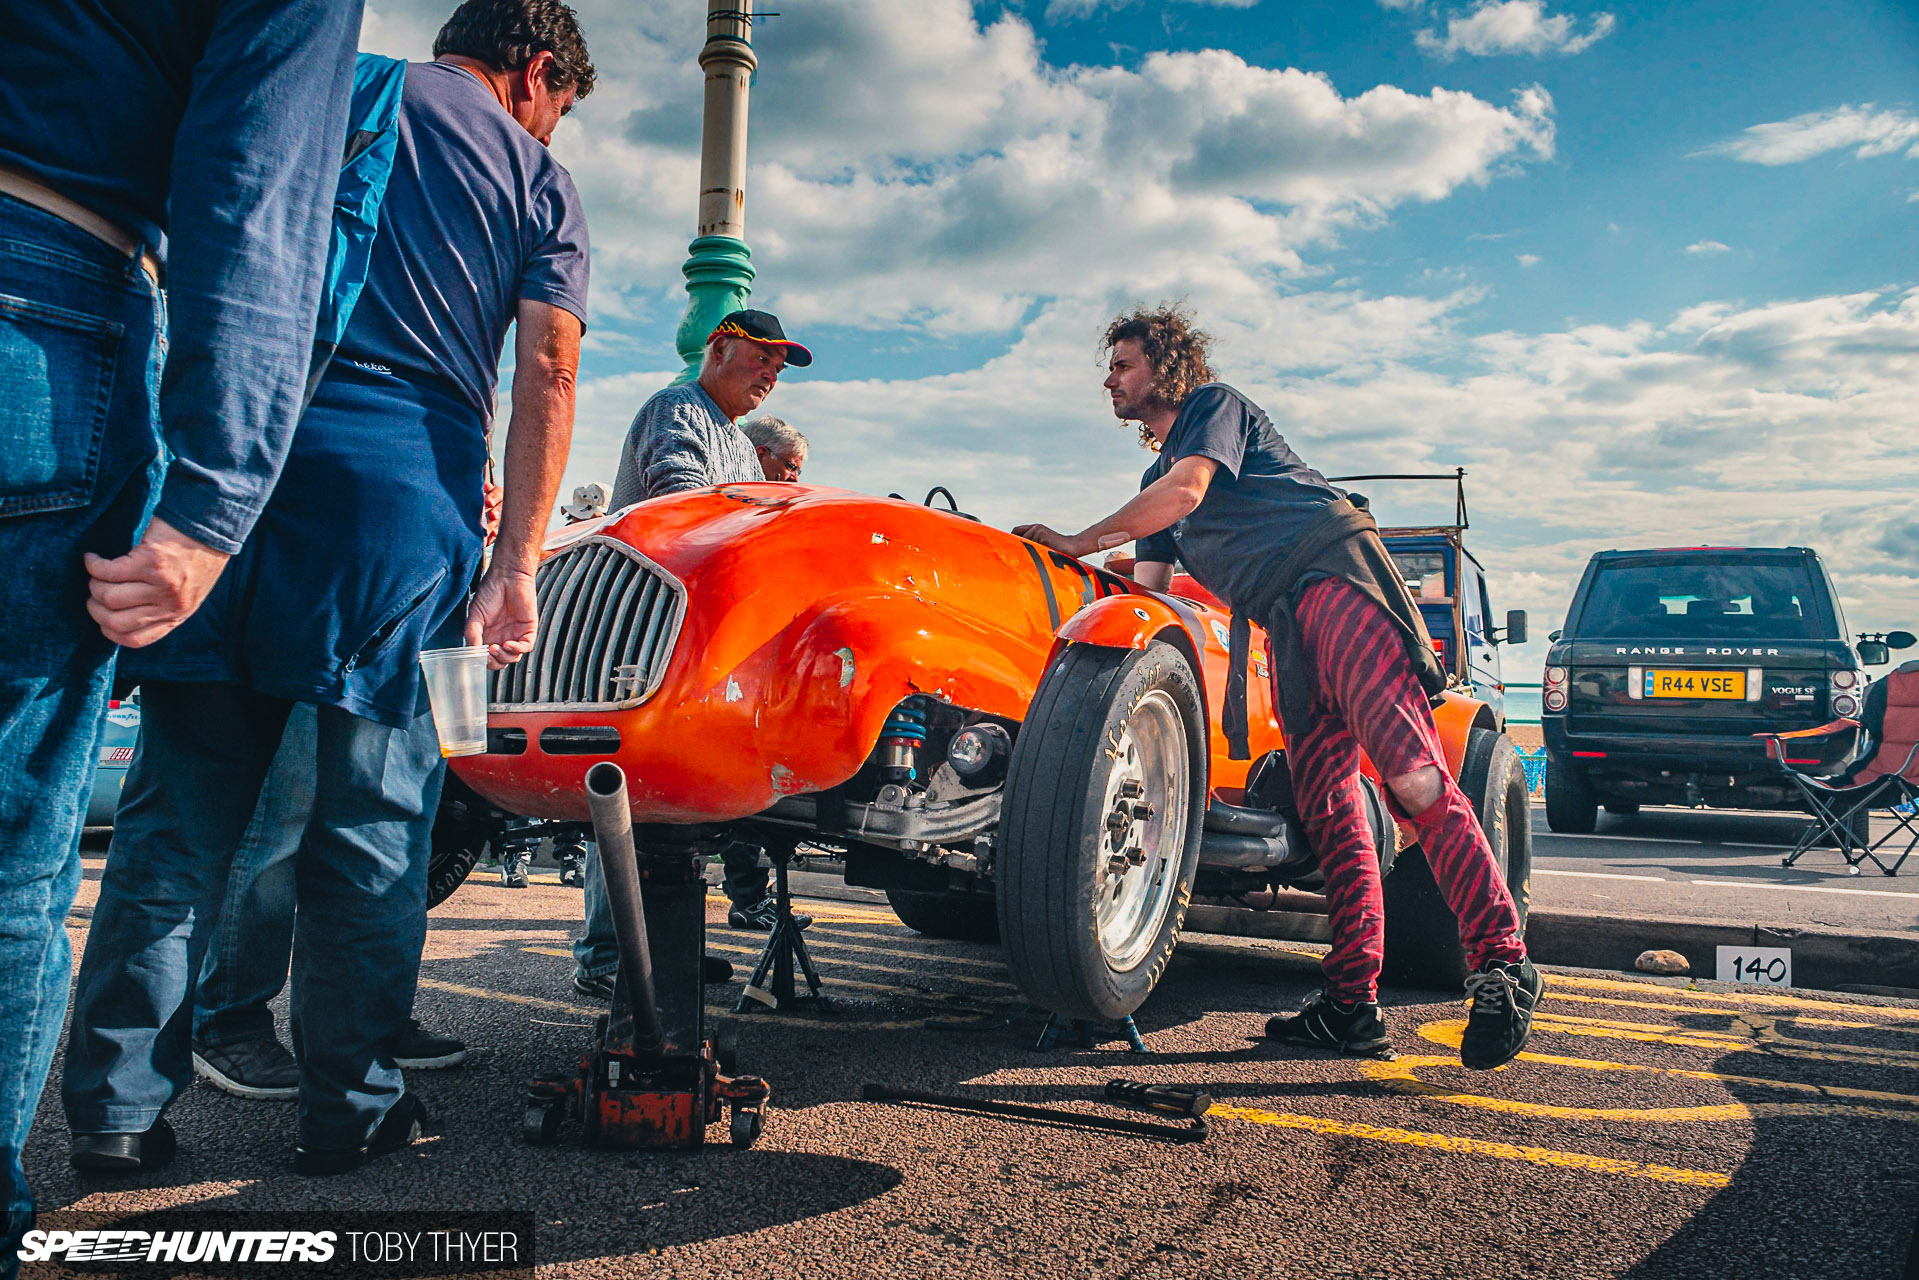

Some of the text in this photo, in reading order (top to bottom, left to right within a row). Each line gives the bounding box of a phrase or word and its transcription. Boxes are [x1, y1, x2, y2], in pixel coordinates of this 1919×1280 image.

[1616, 647, 1779, 656] RANGE ROVER
[1662, 677, 1733, 692] R44 VSE
[1771, 687, 1803, 695] VOGUE
[1733, 956, 1787, 982] 140
